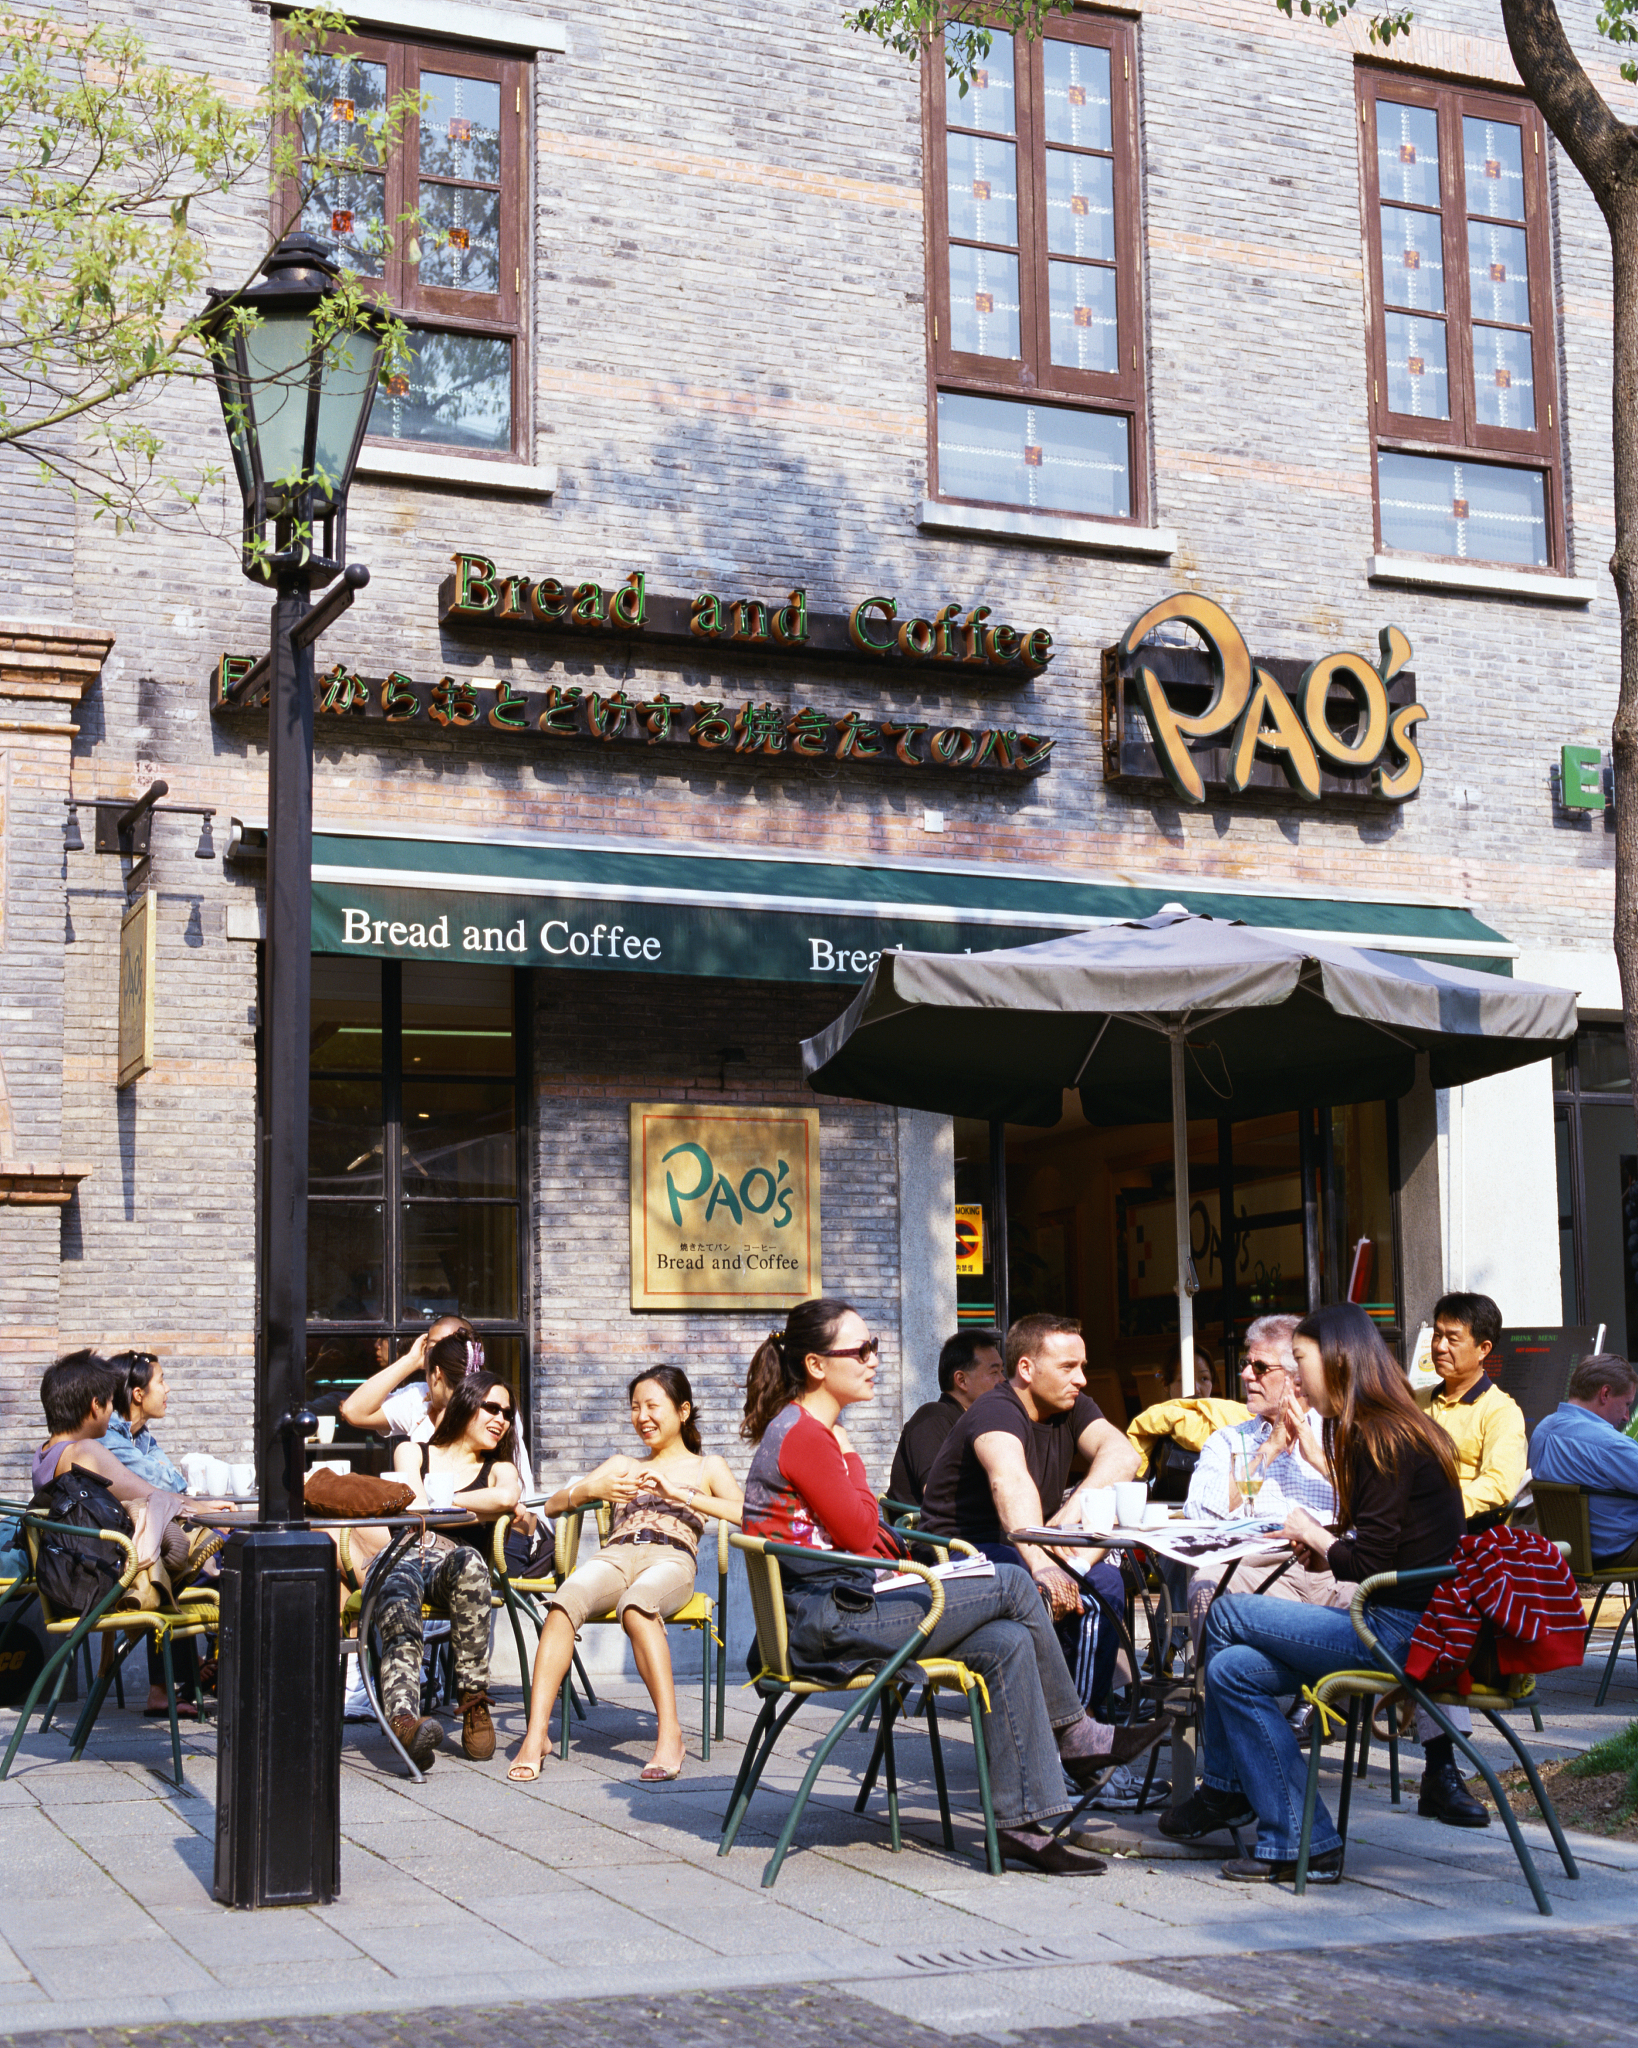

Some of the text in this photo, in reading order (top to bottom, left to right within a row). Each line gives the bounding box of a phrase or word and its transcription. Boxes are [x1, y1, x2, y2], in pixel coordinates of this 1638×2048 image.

[448, 552, 1055, 670] Bread and Coffee
[1561, 745, 1606, 810] E
[341, 908, 663, 961] Bread and Coffee
[808, 938, 903, 973] Brea
[955, 1206, 980, 1215] MOKING
[680, 1242, 777, 1252] 焼きたてパン コーヒー
[657, 1254, 799, 1270] Bread and Coffee
[1510, 1334, 1559, 1342] DRINK MENU
